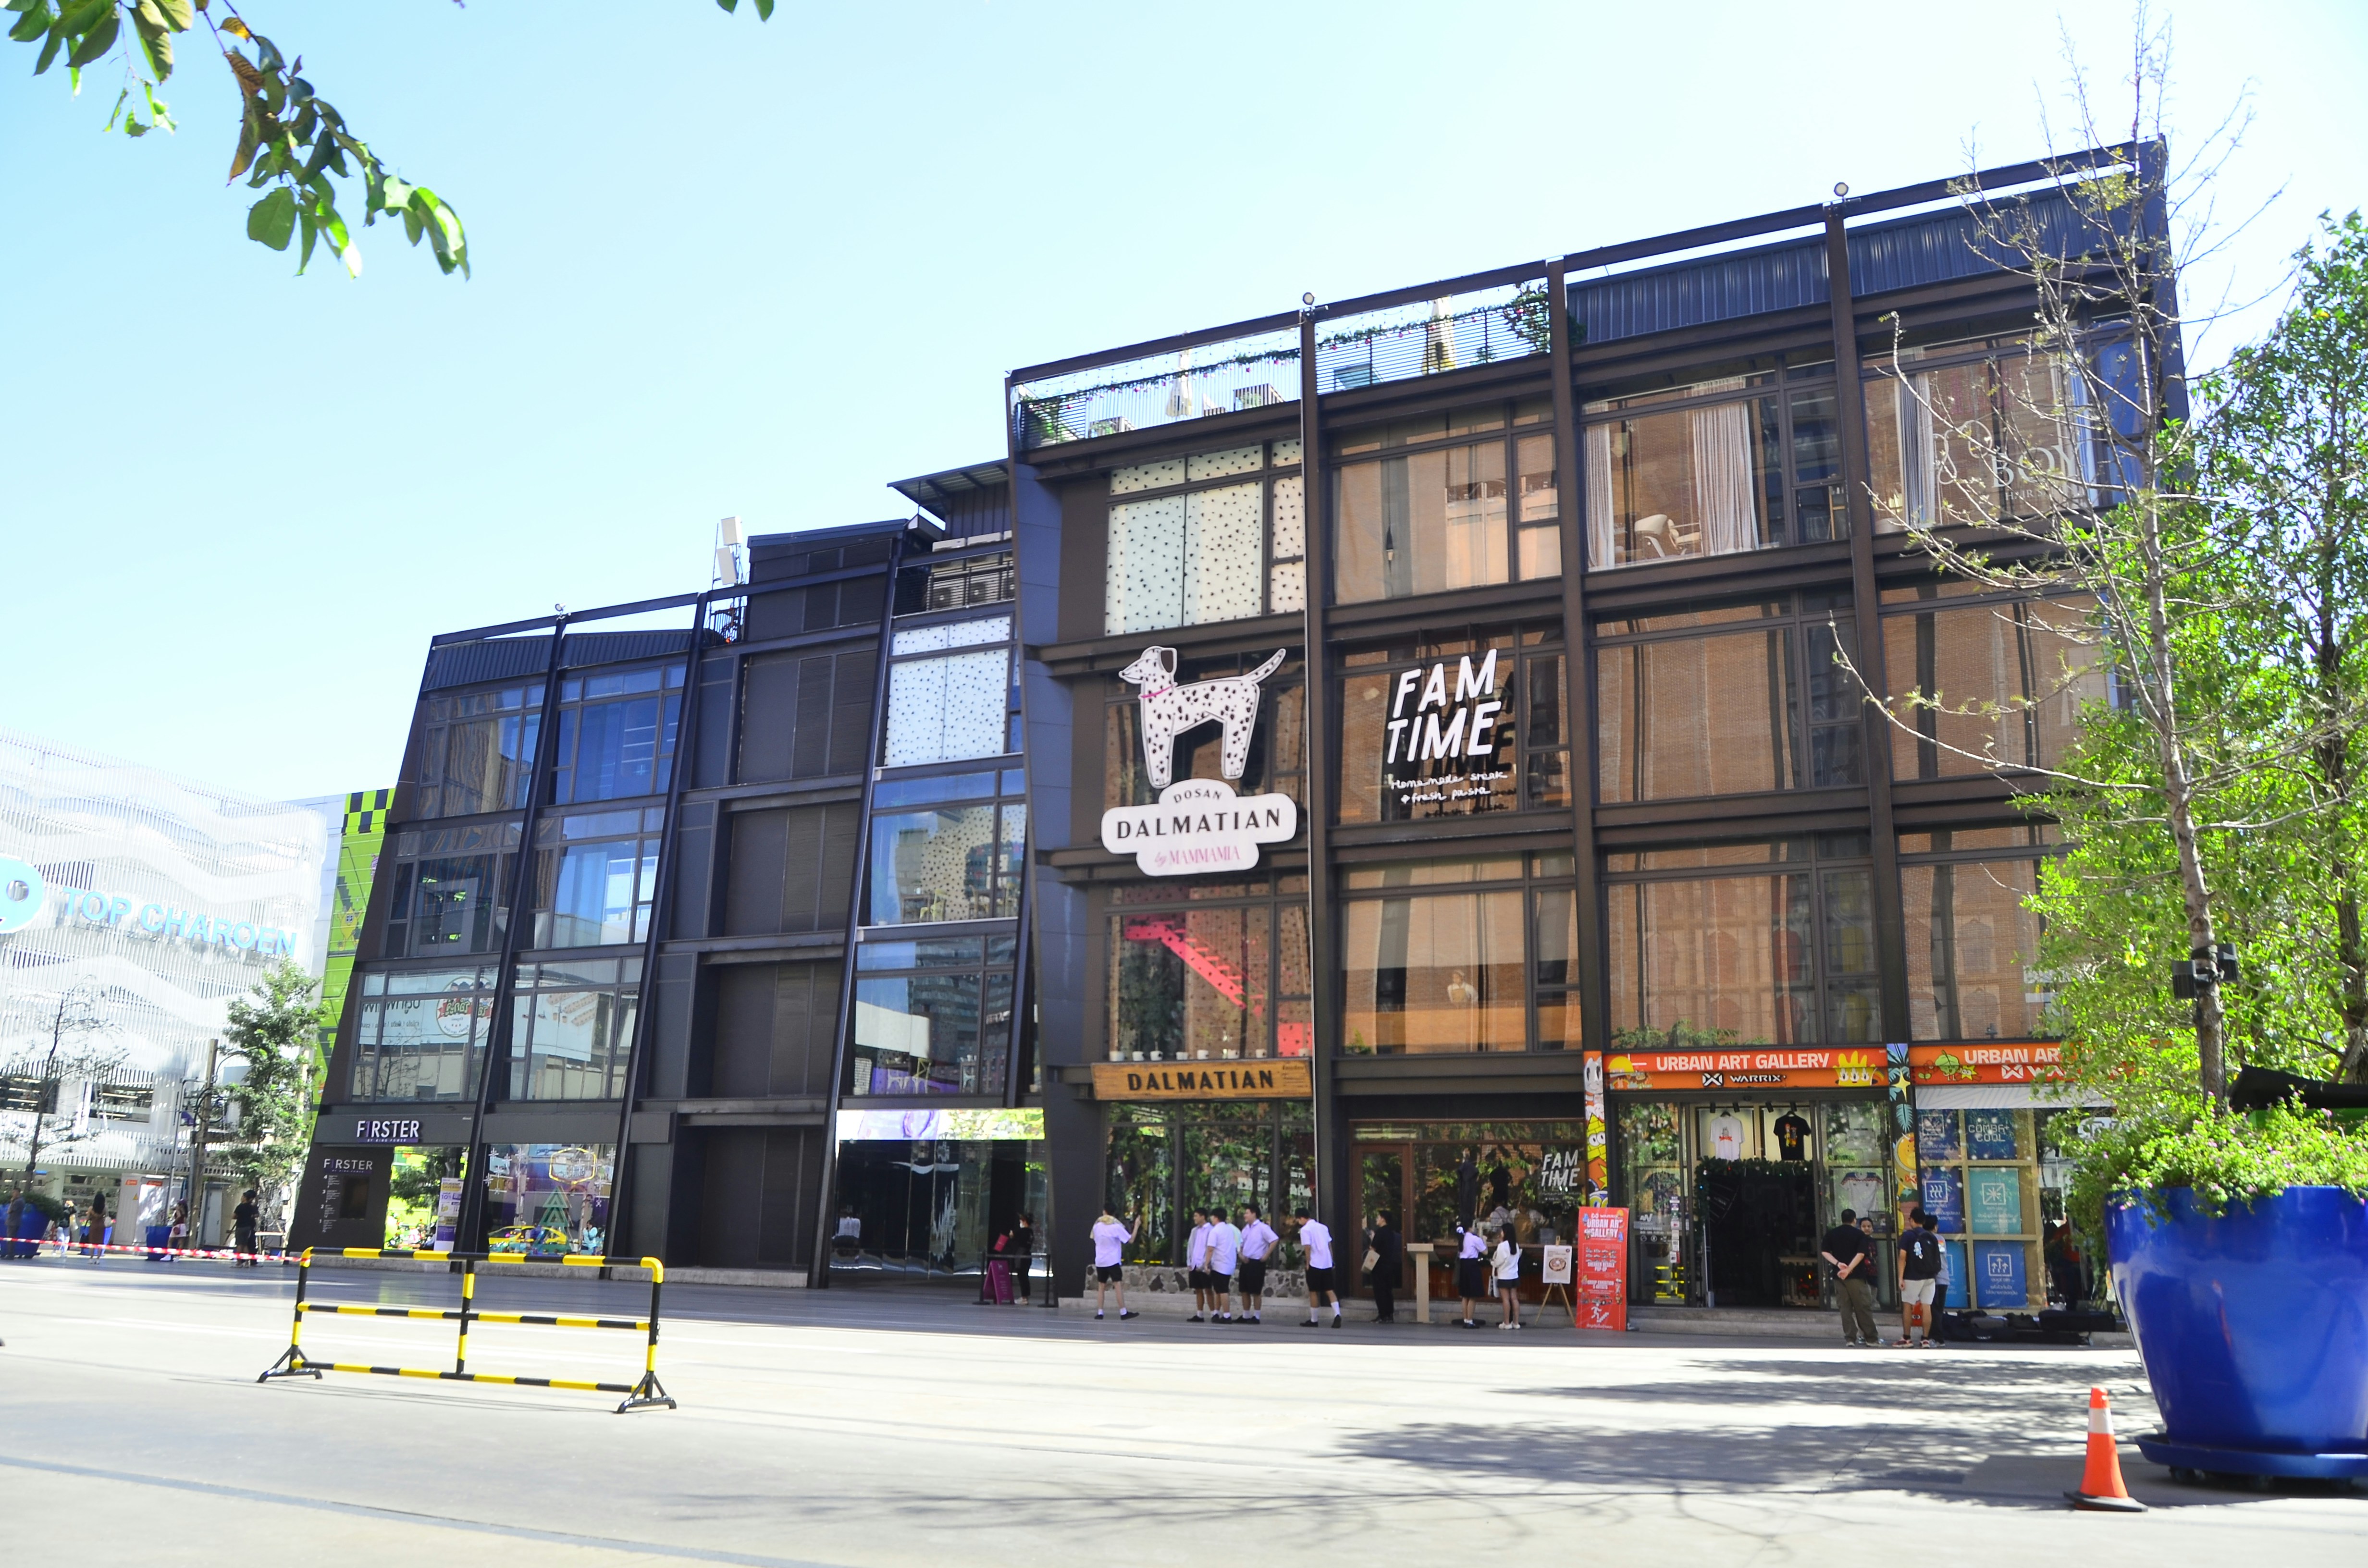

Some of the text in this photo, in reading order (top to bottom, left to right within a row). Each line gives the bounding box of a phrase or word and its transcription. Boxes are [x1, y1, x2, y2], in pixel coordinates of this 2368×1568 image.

[1393, 649, 1497, 719] FAM
[1387, 700, 1502, 764] TIME
[1470, 771, 1508, 781] steak
[1173, 788, 1222, 804] DOSAN
[1117, 808, 1280, 839] DALMATIAN
[1155, 846, 1240, 867] by MAMMAMIA
[63, 887, 297, 957] TOP CHAROEN
[1656, 1053, 1830, 1071] URBAN ART GALLERY
[1964, 1047, 2061, 1064] URBAN AR
[1127, 1070, 1274, 1091] DALMATIAN
[1730, 1074, 1781, 1083] WARRIX
[1543, 1149, 1579, 1171] FAM
[1542, 1168, 1580, 1187] TIME
[1587, 1219, 1609, 1228] URBAN
